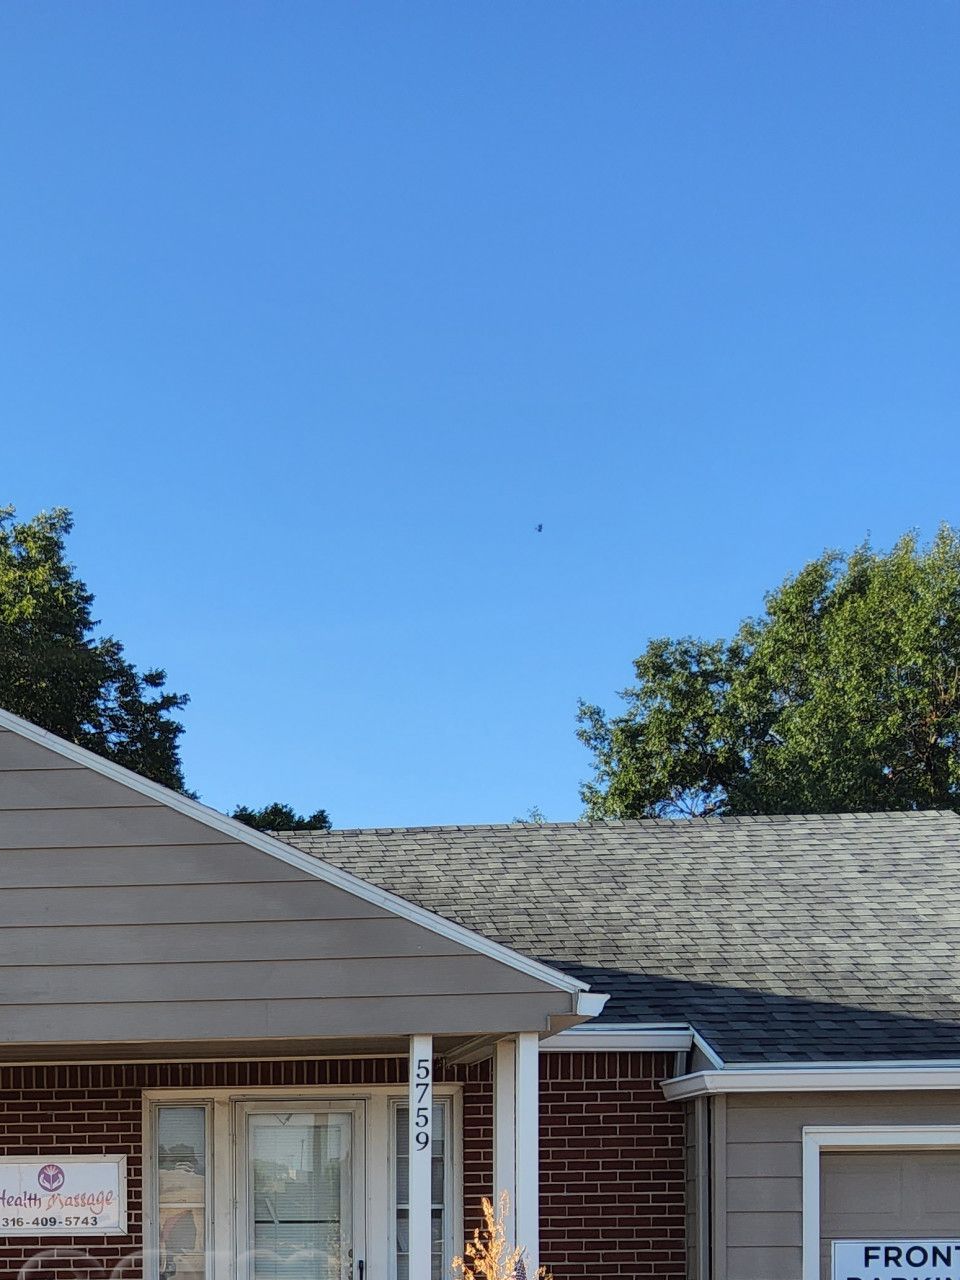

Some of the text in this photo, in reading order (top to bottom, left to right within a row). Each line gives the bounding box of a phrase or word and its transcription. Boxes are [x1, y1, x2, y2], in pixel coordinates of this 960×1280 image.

[415, 1059, 430, 1152] 5759
[45, 1189, 114, 1215] Massage
[2, 1216, 99, 1228] 316-409-5743
[864, 1246, 960, 1268] FRON
